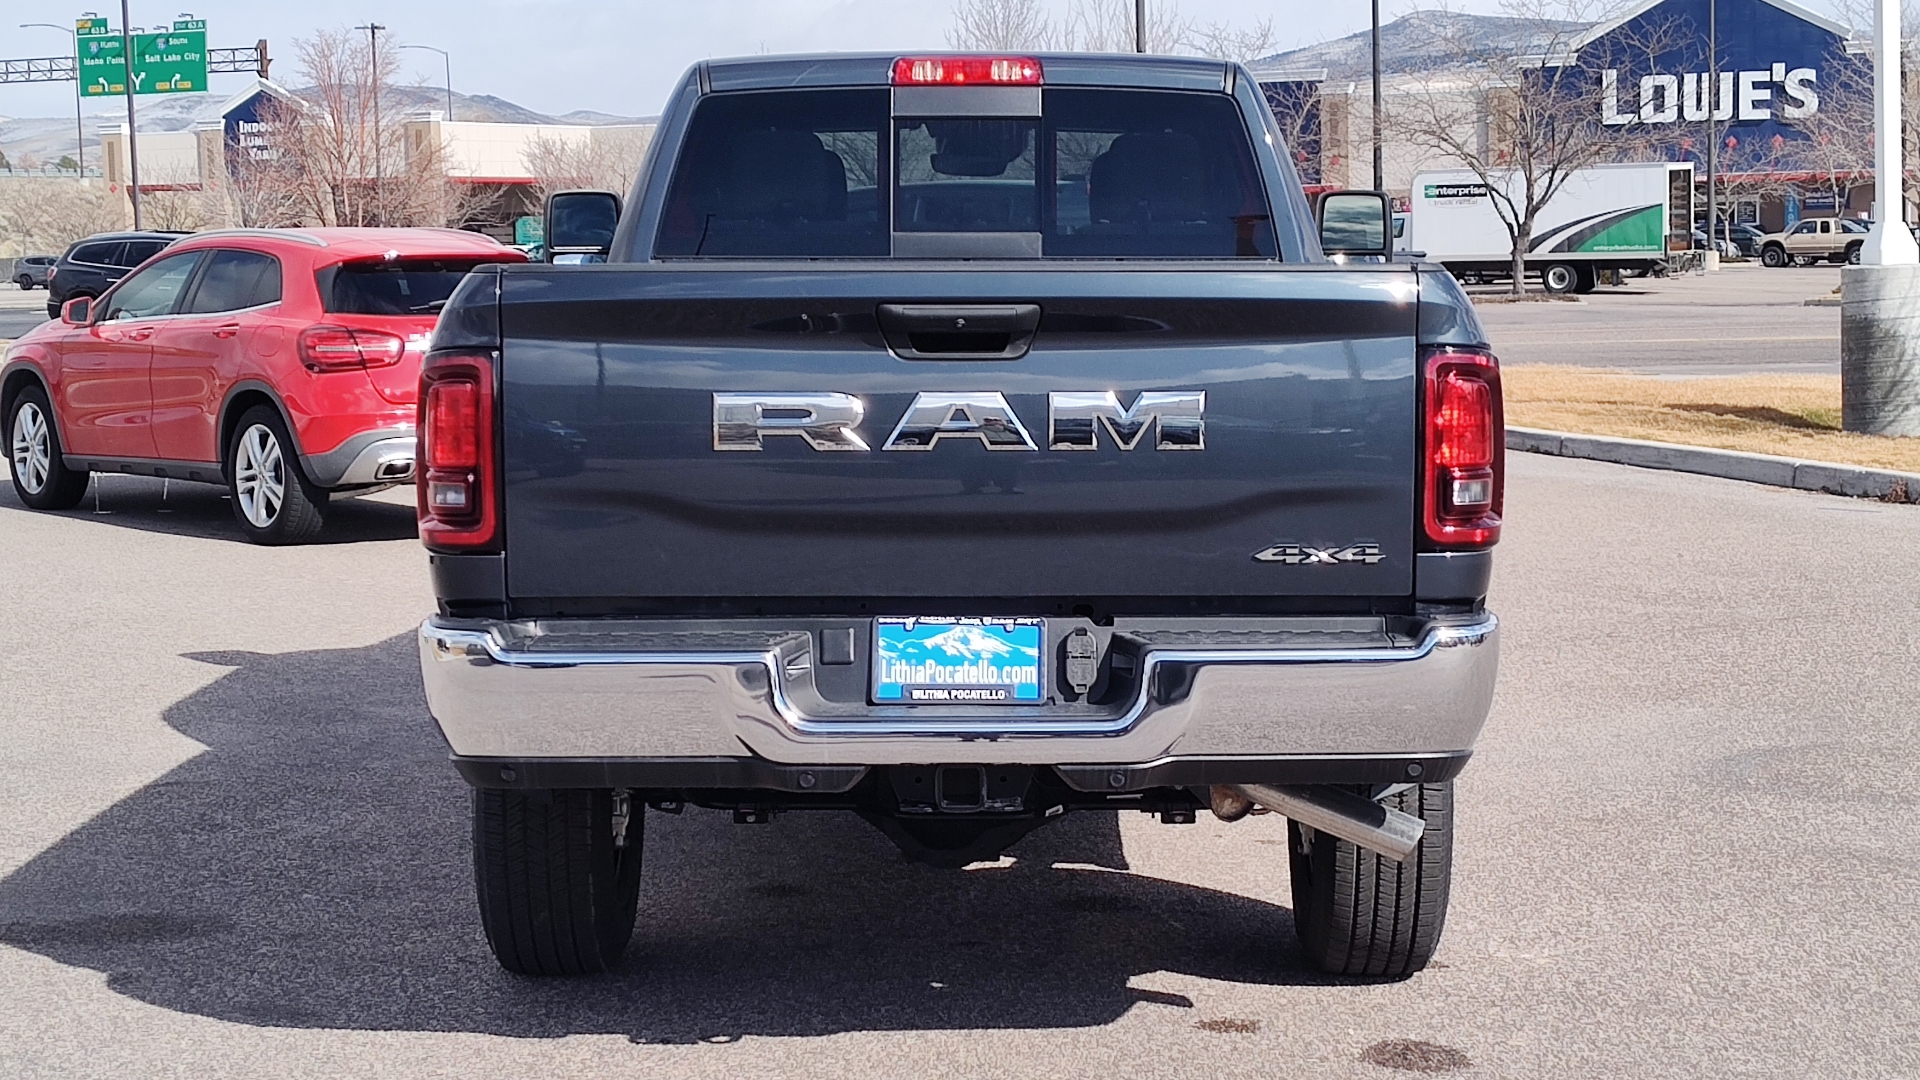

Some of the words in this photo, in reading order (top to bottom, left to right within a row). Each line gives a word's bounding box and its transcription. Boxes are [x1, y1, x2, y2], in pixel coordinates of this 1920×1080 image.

[83, 57, 104, 65] Idaho
[106, 56, 125, 65] Falls
[145, 54, 161, 62] Salt
[163, 53, 181, 61] Lake
[184, 52, 200, 61] City
[1601, 62, 1819, 125] LOWE'S
[239, 120, 276, 133] INDOO
[1426, 185, 1487, 196] enterprise
[712, 391, 1207, 452] RAM
[881, 659, 1037, 683] LithiaPocatello.com
[951, 689, 1006, 700] POCATELLO
